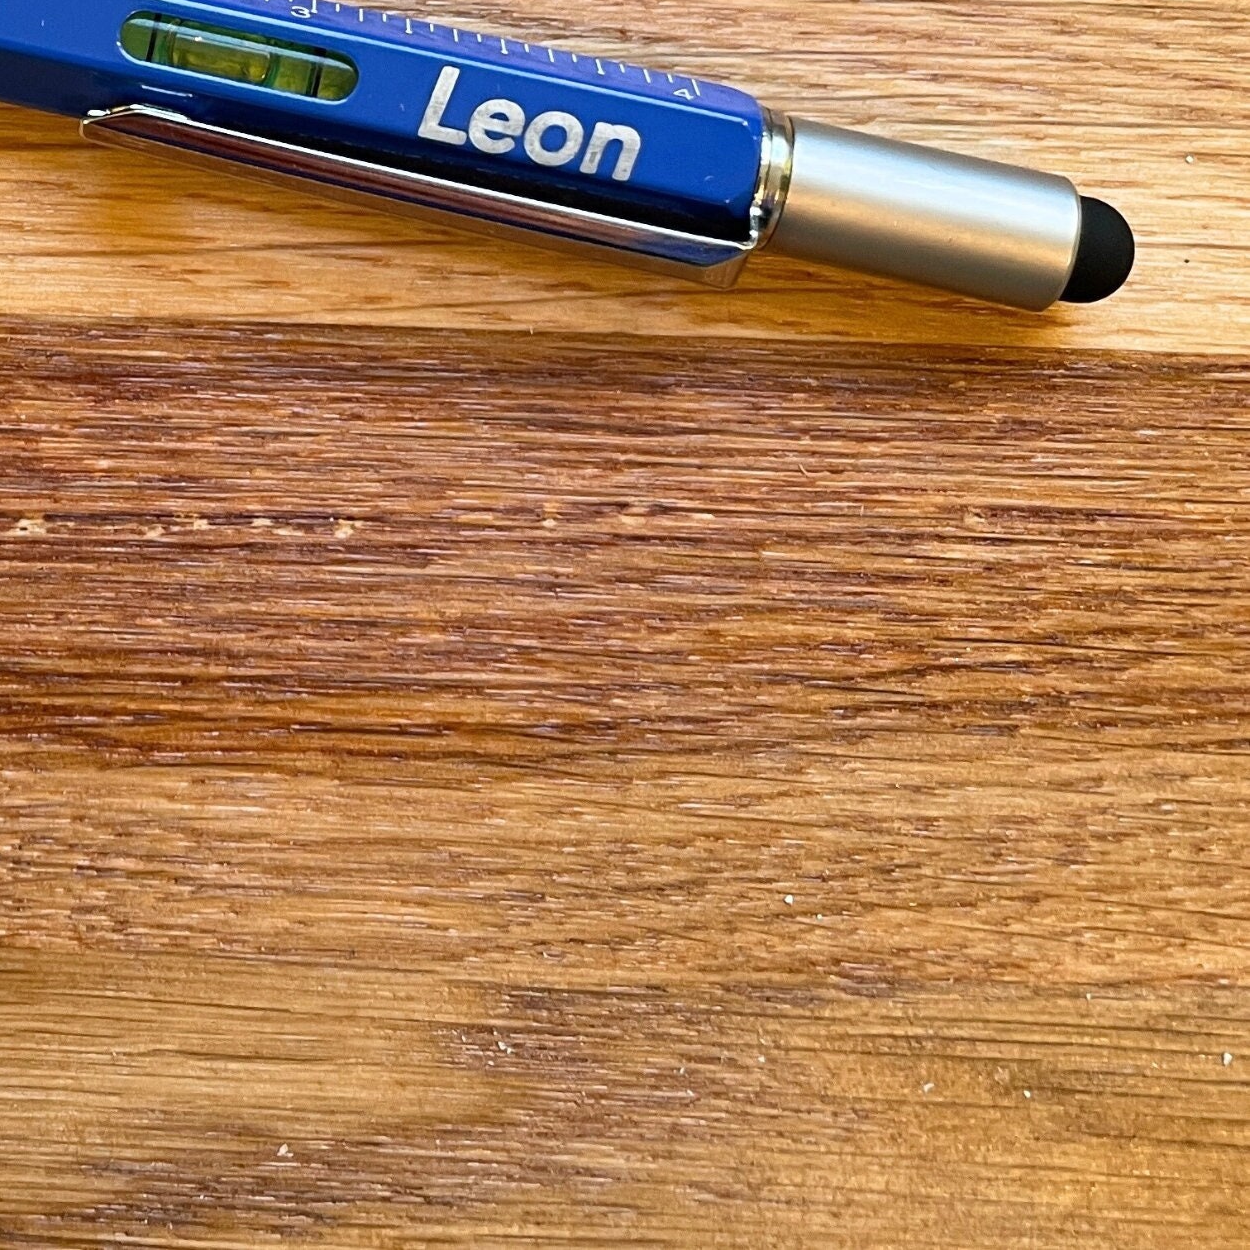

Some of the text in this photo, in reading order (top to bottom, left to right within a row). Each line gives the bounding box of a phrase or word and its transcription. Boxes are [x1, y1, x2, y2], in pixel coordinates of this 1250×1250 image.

[290, 5, 311, 19] 3
[672, 88, 695, 101] 4
[417, 65, 642, 182] Leon
